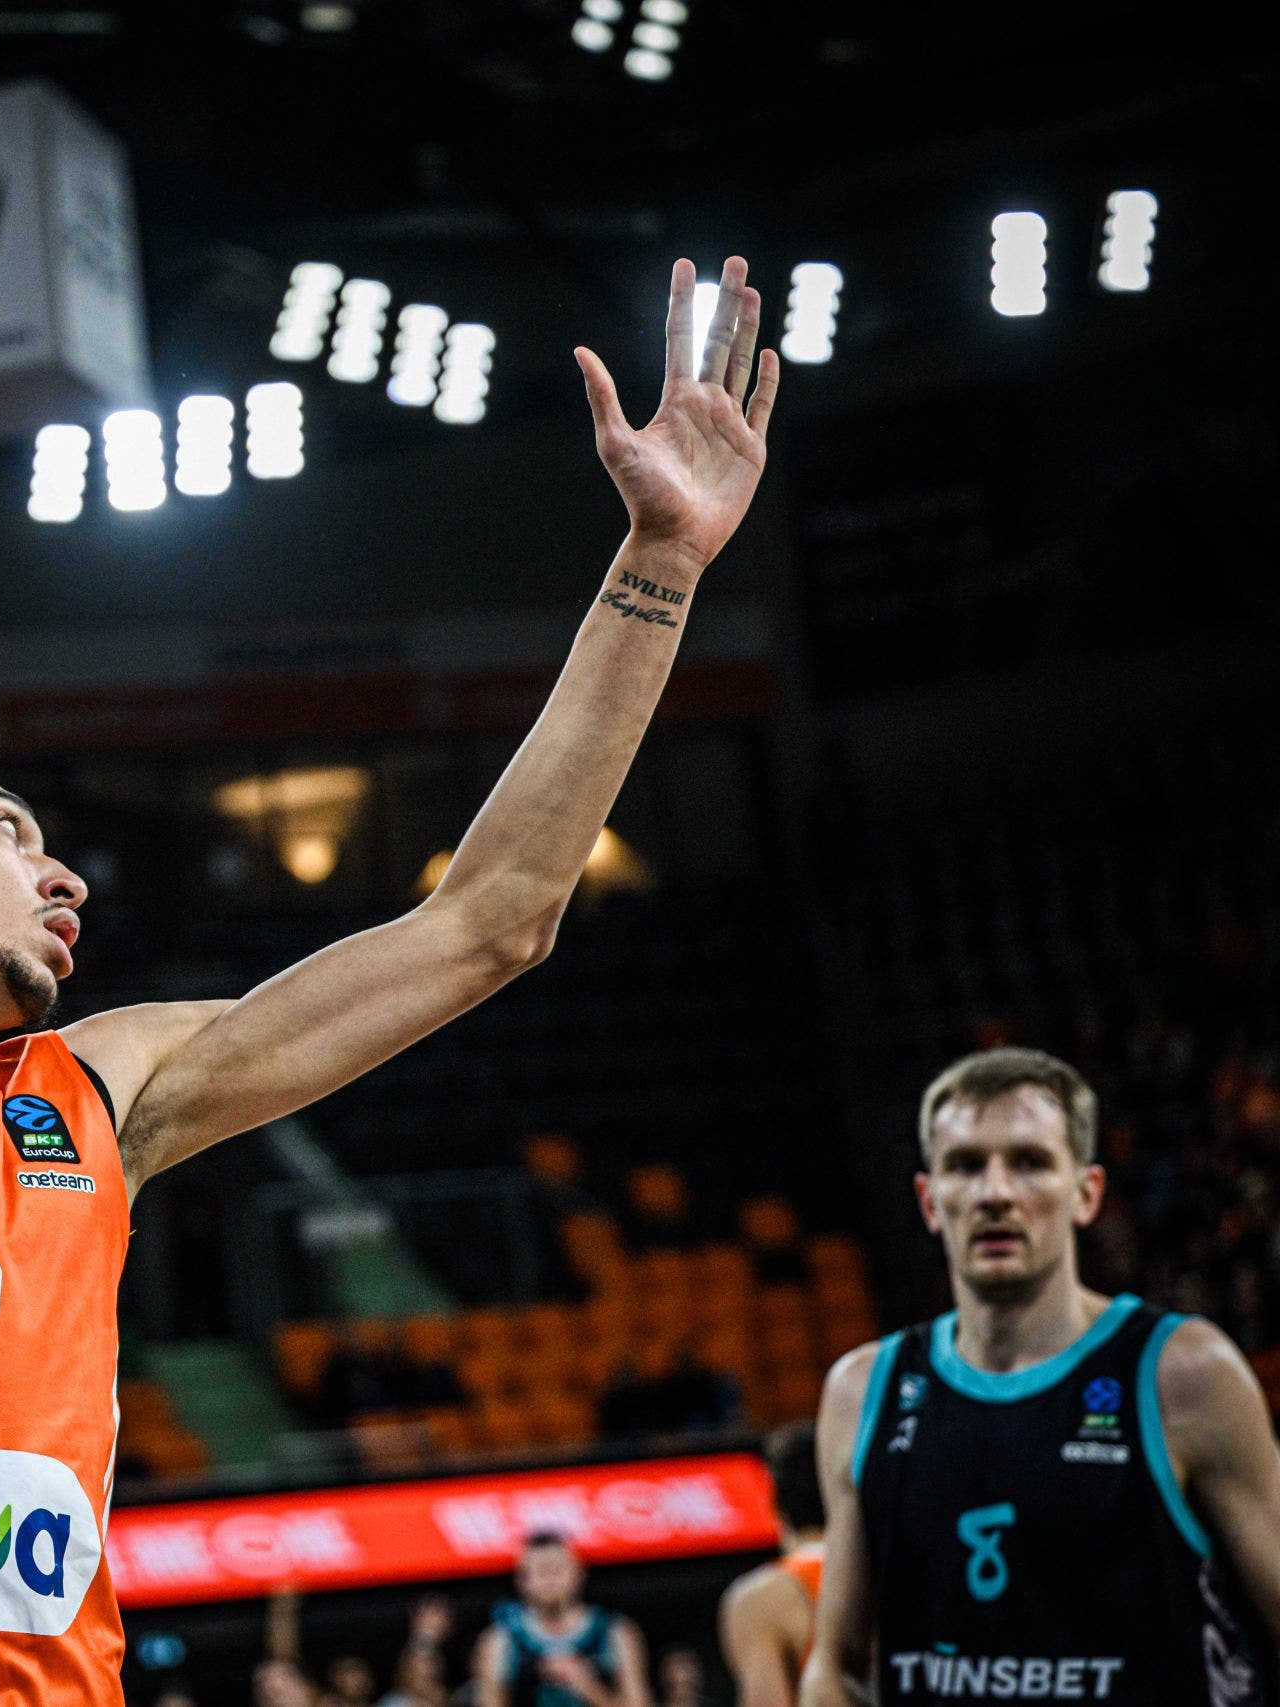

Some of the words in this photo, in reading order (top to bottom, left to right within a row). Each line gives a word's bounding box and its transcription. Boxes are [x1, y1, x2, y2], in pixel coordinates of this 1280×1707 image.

[23, 1134, 63, 1146] BKT
[22, 1147, 75, 1159] EuroCup
[17, 1170, 95, 1193] oneteam
